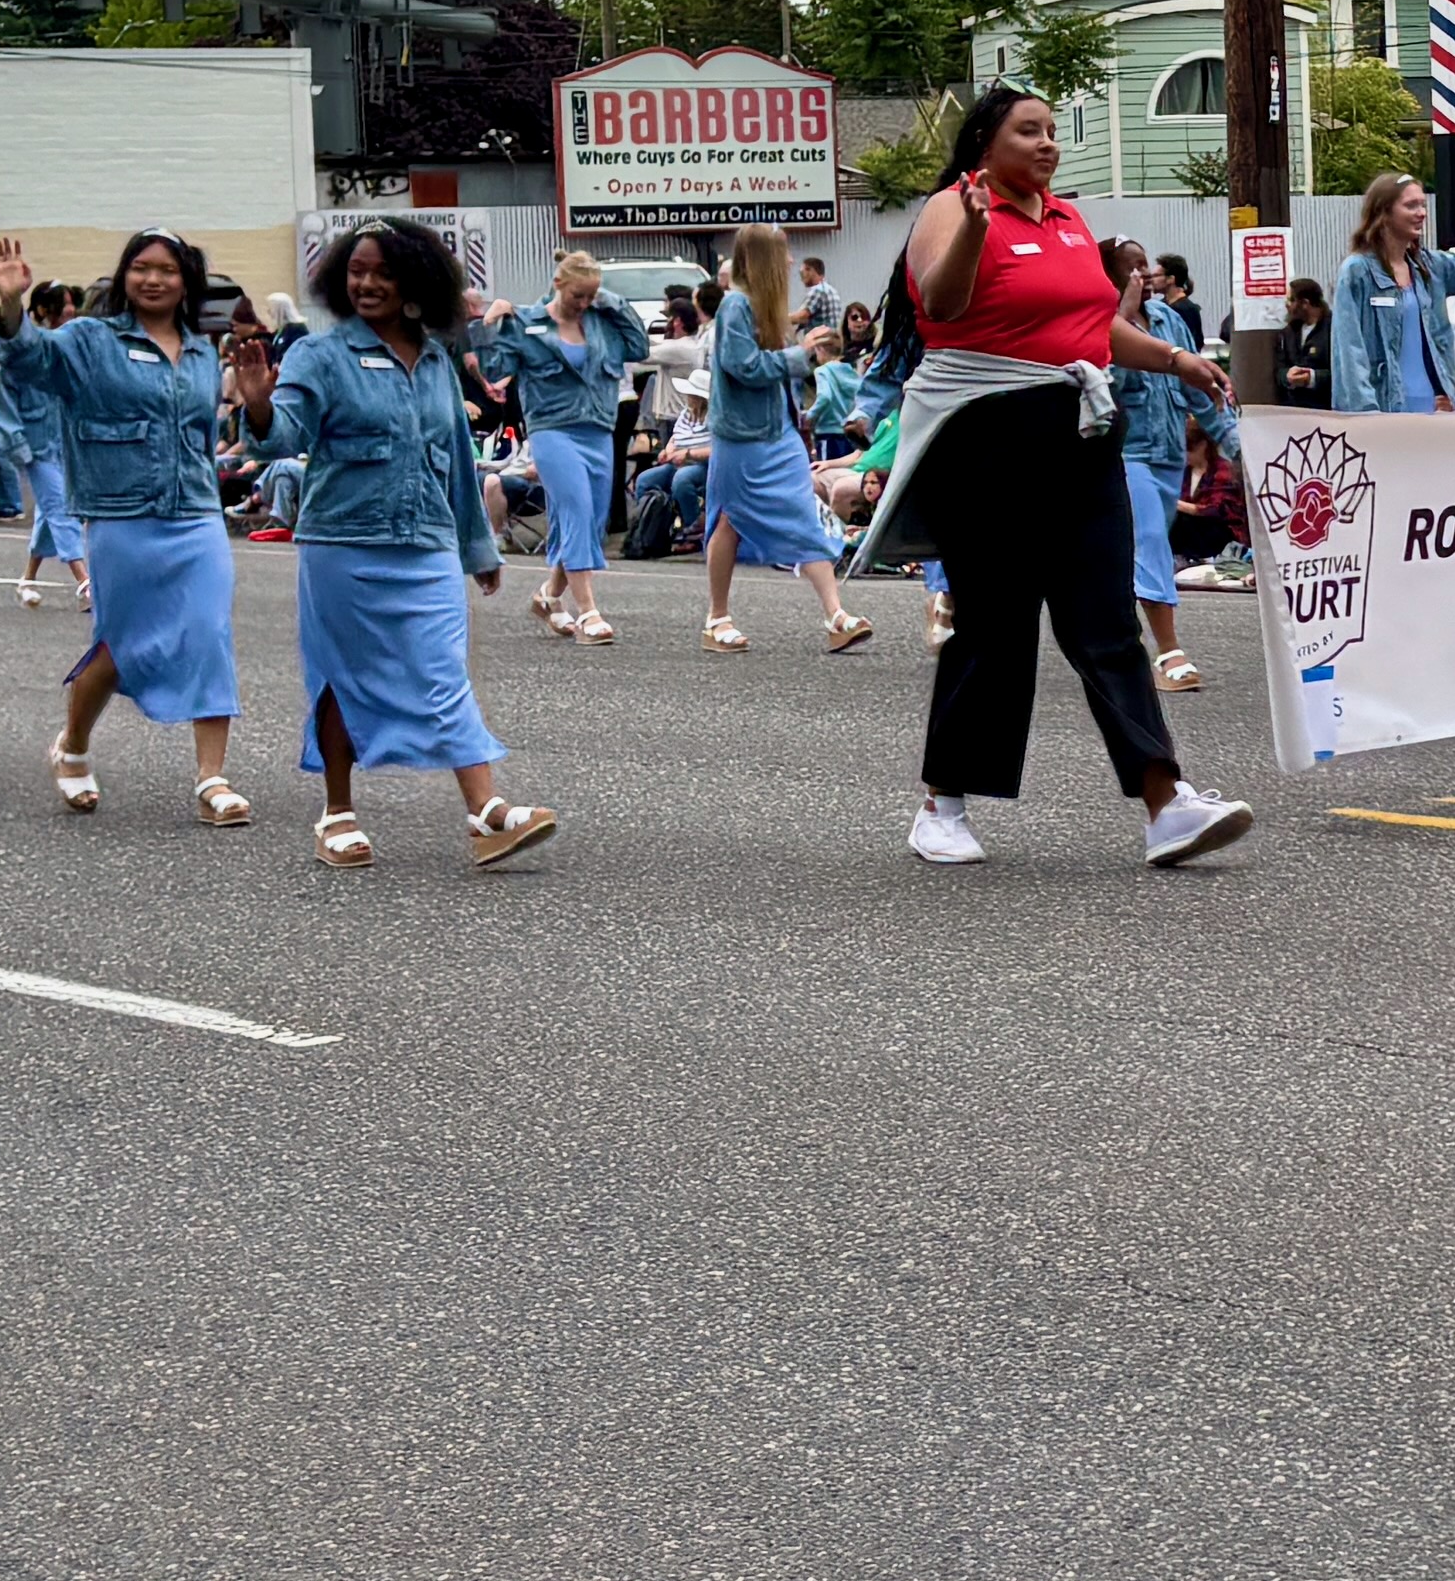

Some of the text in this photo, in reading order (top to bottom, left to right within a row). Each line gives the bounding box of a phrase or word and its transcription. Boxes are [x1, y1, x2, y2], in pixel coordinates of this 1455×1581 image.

[572, 92, 588, 143] THE
[577, 148, 826, 166] Where Guys Go For Great Cuts
[608, 178, 657, 197] Open
[663, 178, 673, 193] 7
[681, 177, 723, 196] Days
[730, 177, 742, 192] A
[749, 175, 798, 192] Week
[573, 204, 832, 225] www.TheBarbersOnline.com
[1295, 554, 1362, 580] FESTIVAL
